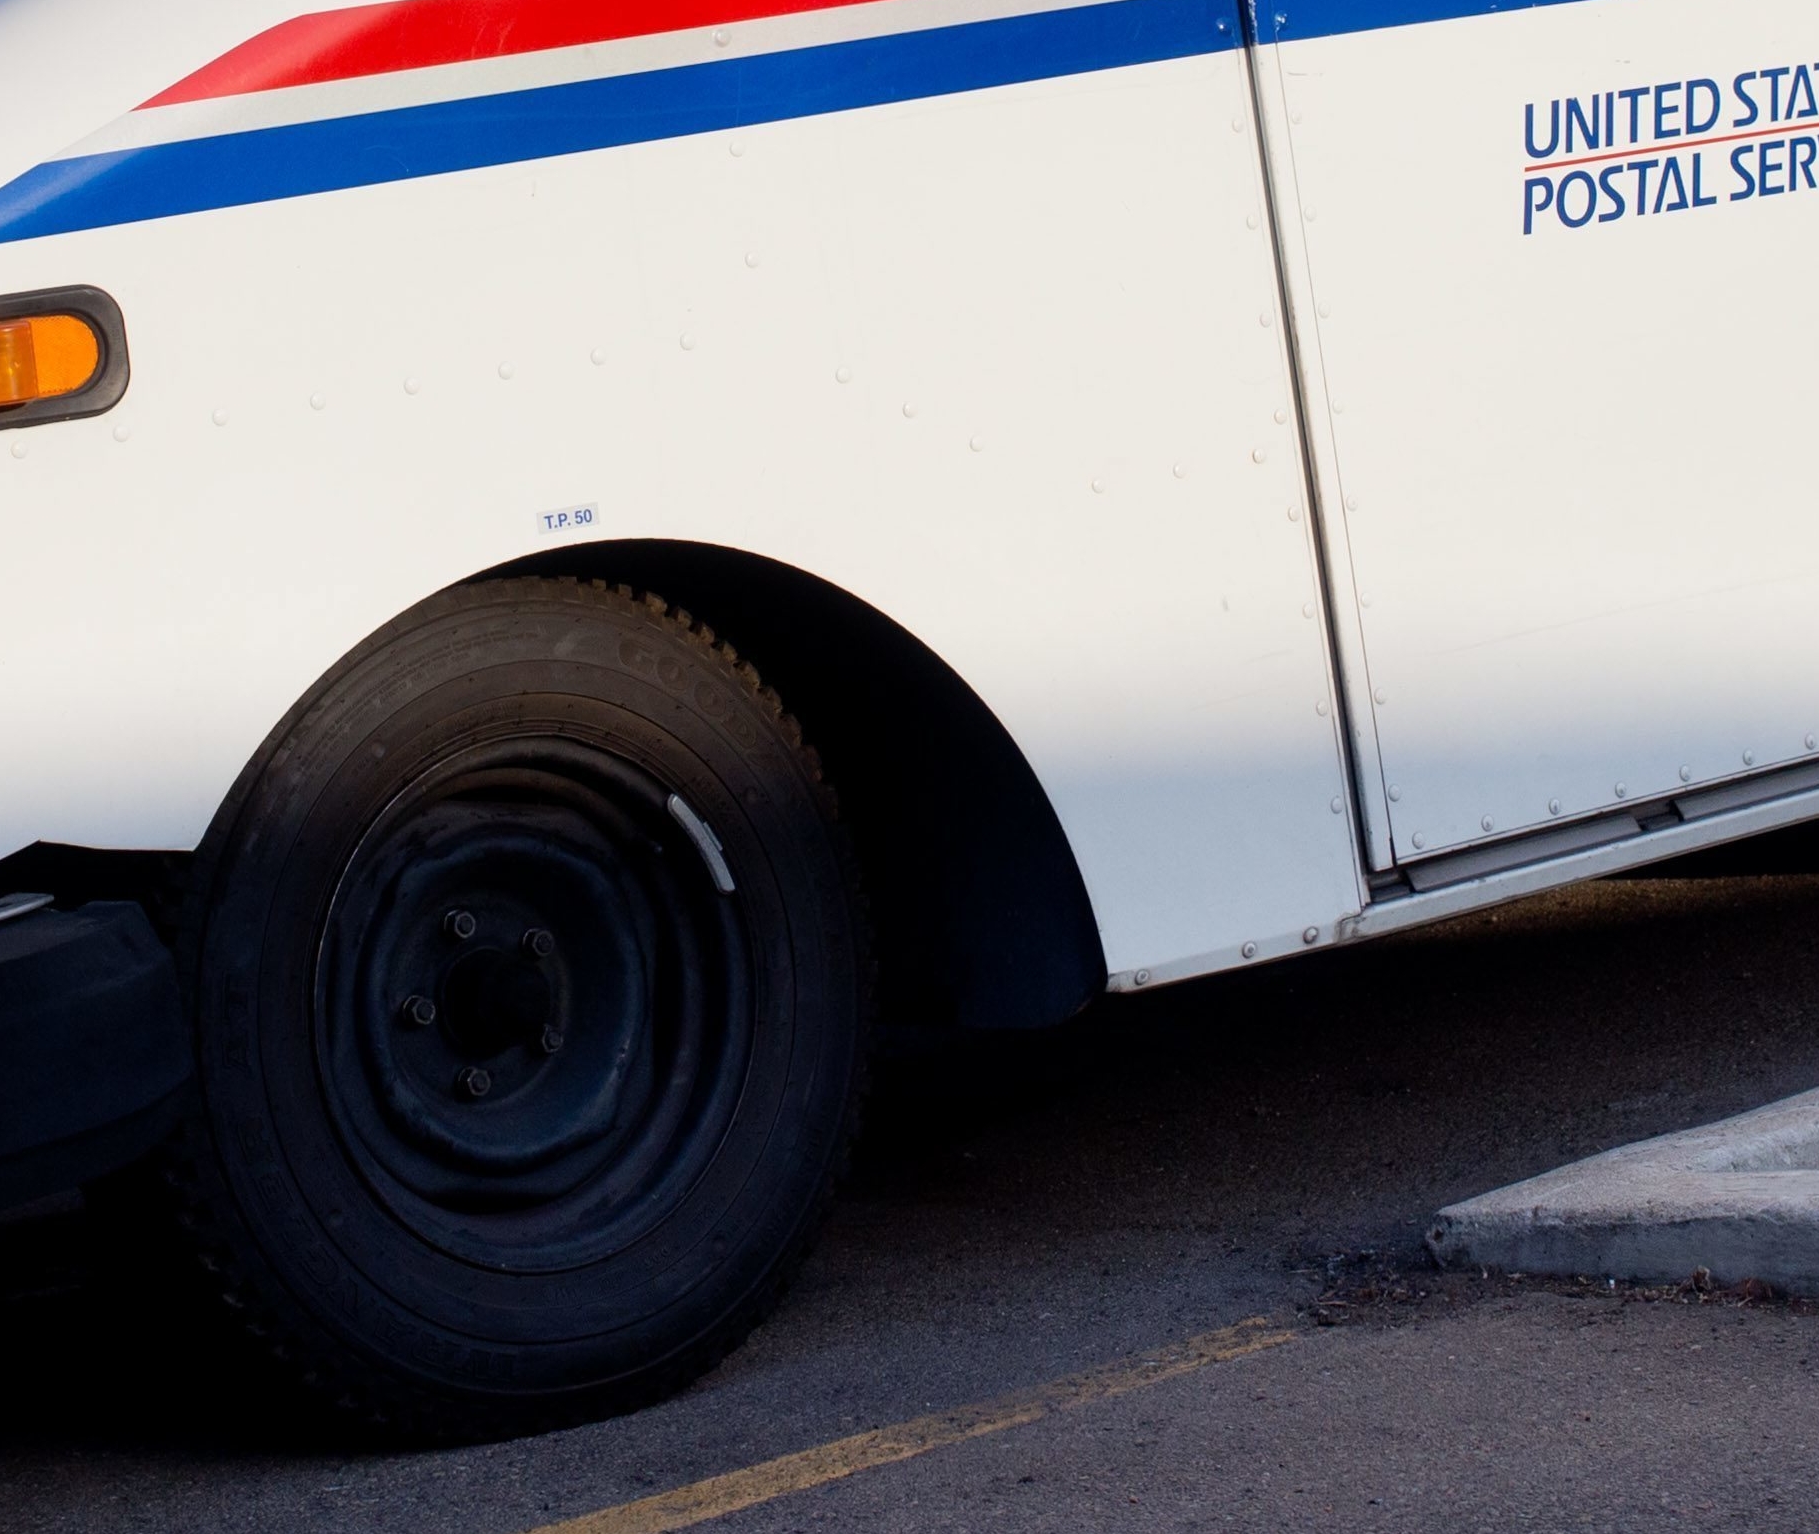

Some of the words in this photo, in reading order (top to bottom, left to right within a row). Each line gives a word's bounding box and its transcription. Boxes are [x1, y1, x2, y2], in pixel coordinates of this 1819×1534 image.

[1524, 77, 1721, 159] UNITED
[1522, 152, 1718, 235] POSTAL
[544, 512, 571, 529] T.P.
[574, 509, 593, 524] 50
